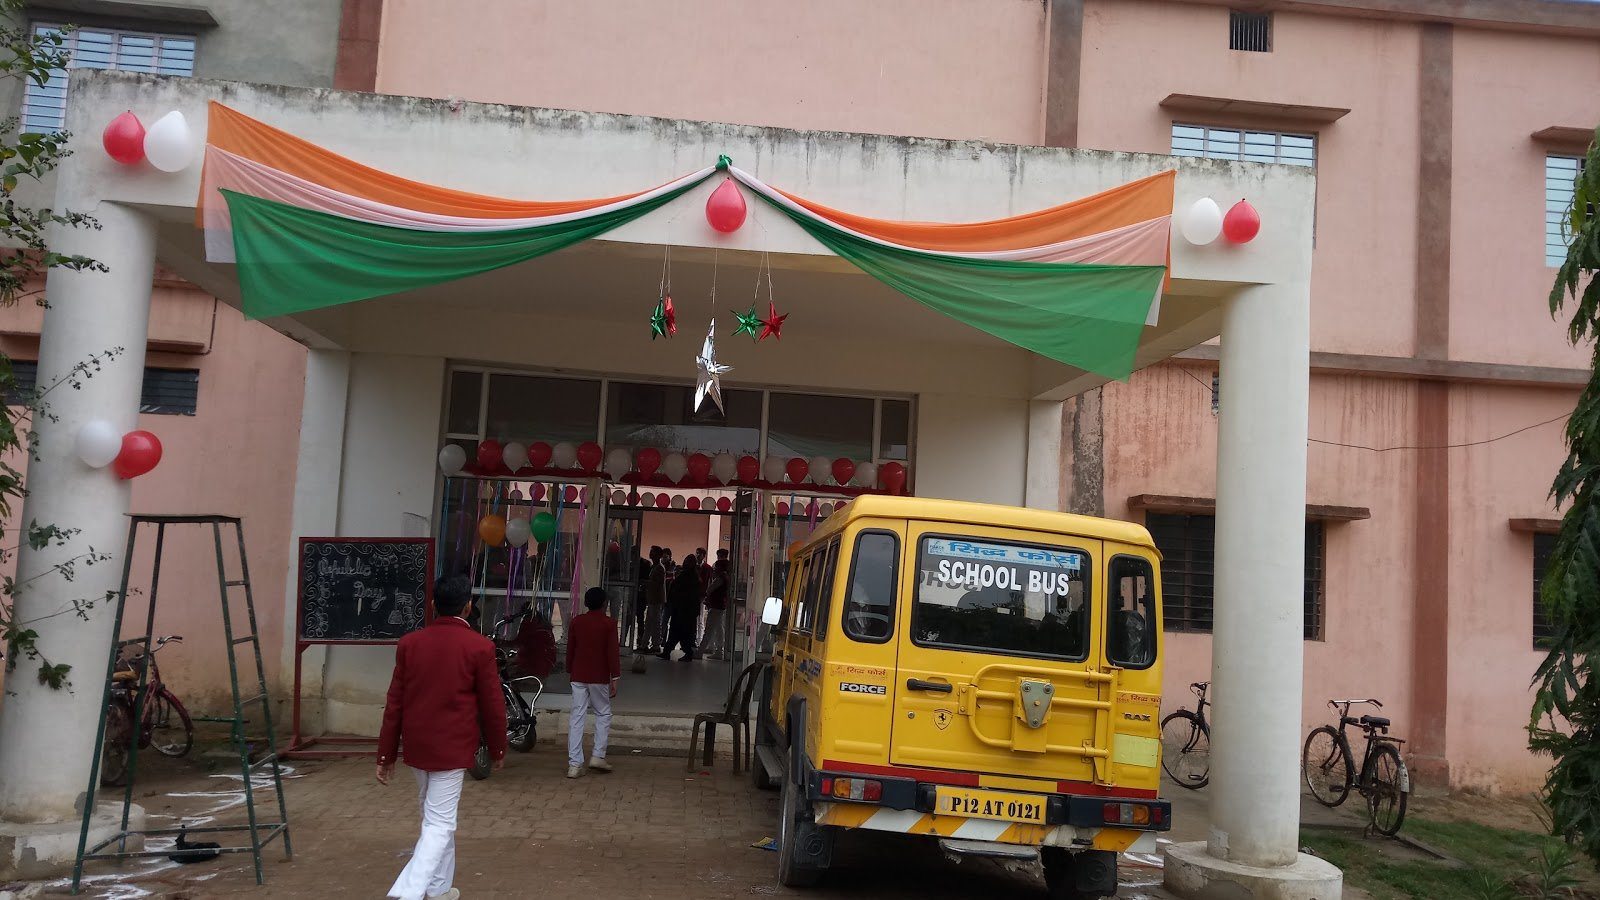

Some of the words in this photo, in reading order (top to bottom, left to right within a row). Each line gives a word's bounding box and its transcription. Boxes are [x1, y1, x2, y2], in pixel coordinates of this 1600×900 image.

[938, 559, 1022, 591] SCHOOL
[1028, 570, 1070, 597] BUS
[840, 682, 885, 695] FORCE
[1123, 712, 1151, 722] RAX
[983, 800, 1004, 816] AT
[1007, 802, 1041, 820] 0121
